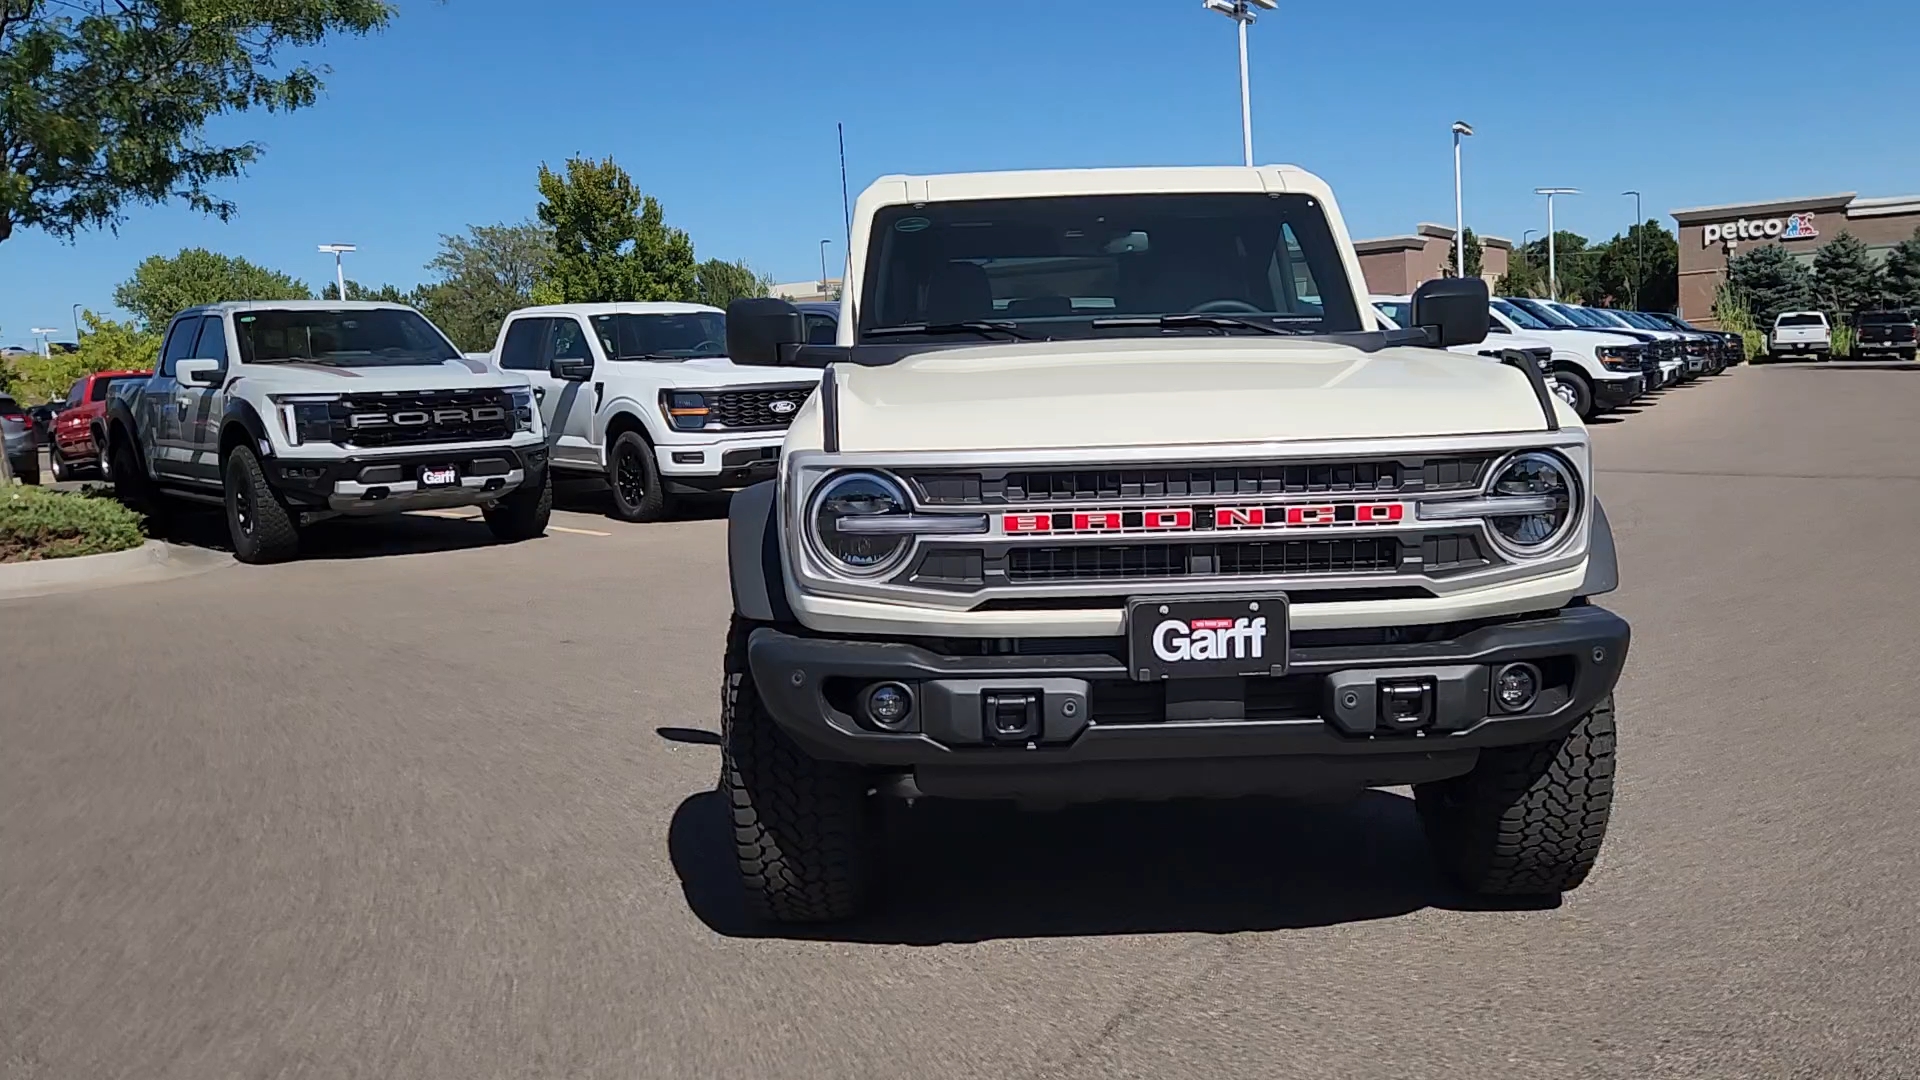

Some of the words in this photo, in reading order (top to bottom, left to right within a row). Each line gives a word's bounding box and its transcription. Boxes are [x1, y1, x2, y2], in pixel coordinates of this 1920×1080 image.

[1704, 218, 1782, 246] petco
[350, 406, 505, 429] FORD
[423, 470, 456, 484] Garff
[1002, 503, 1404, 533] BRONCO
[1152, 617, 1266, 662] Garff
